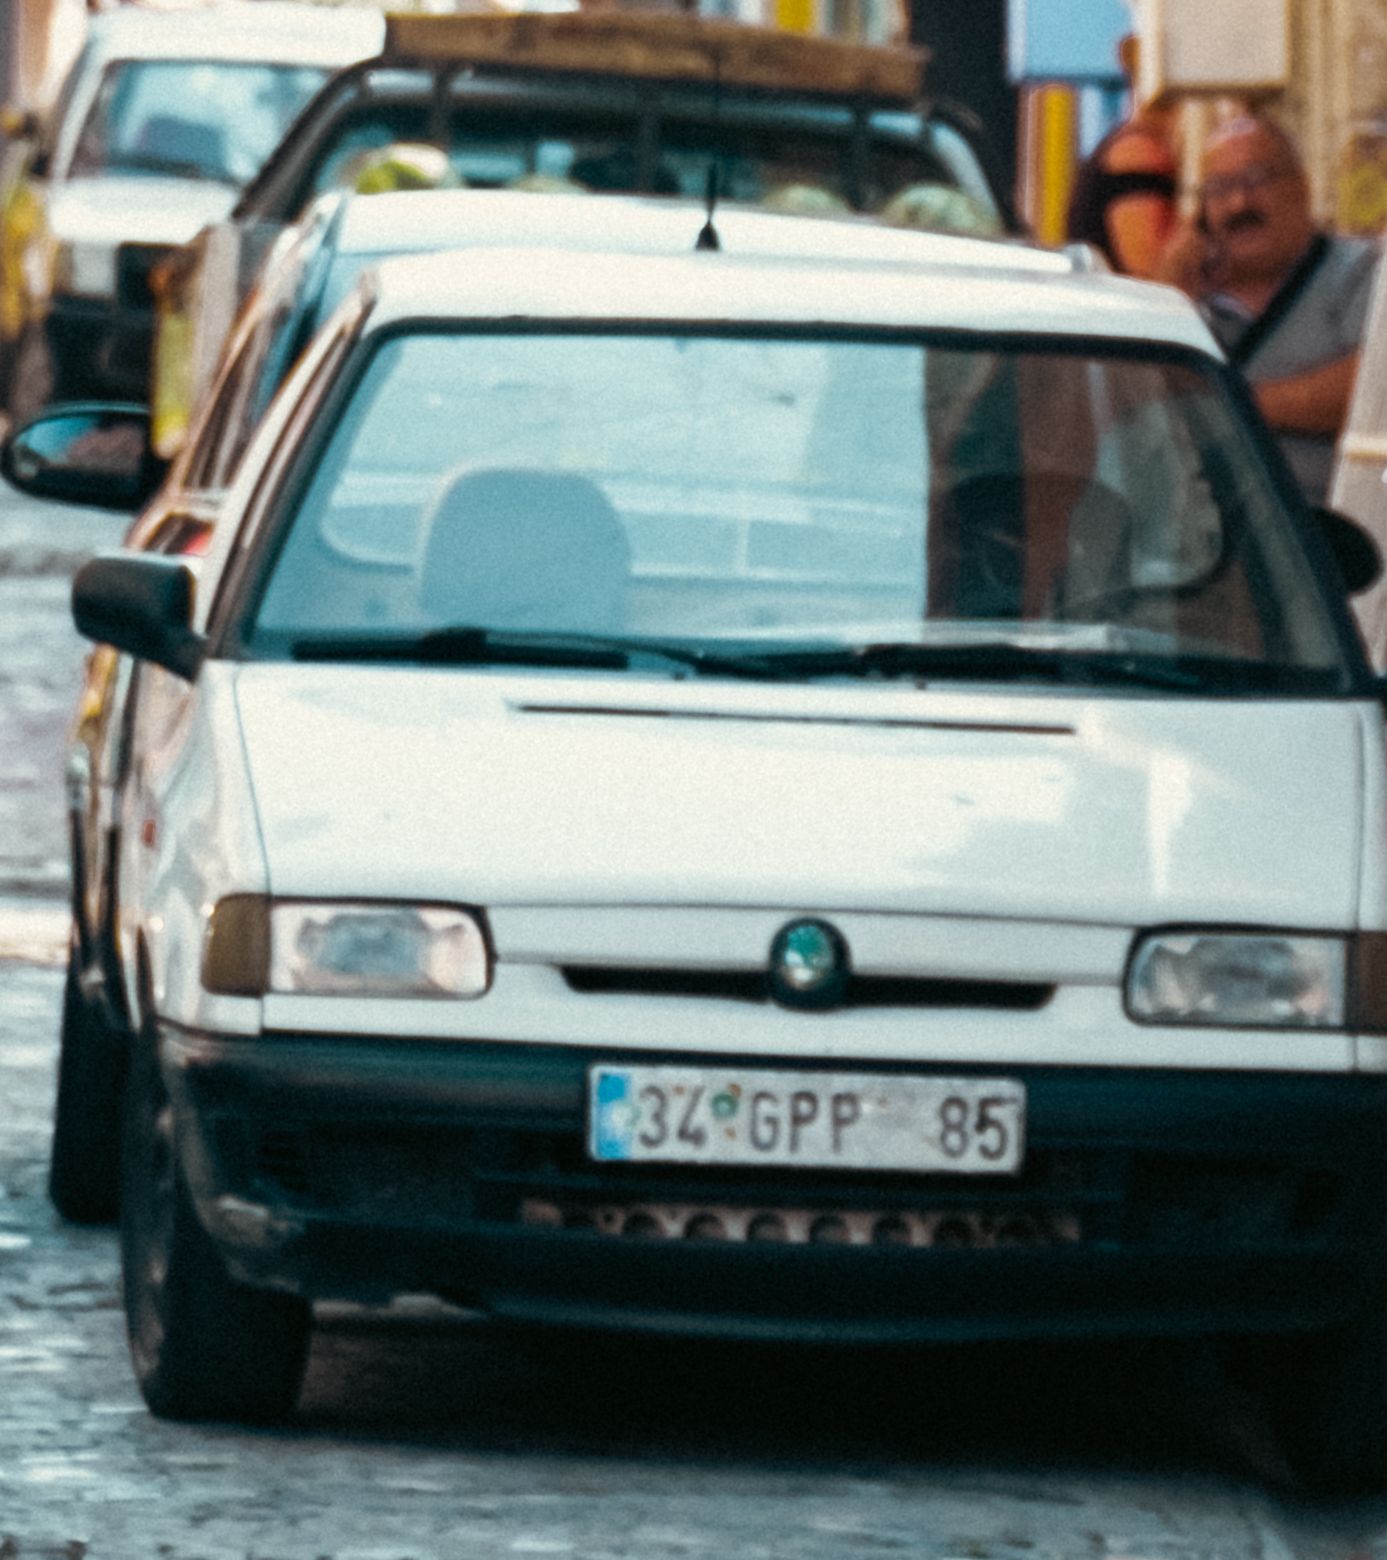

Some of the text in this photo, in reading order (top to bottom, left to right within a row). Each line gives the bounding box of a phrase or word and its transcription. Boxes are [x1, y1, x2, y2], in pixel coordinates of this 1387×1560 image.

[638, 1085, 1010, 1161] 34 GPP 85
